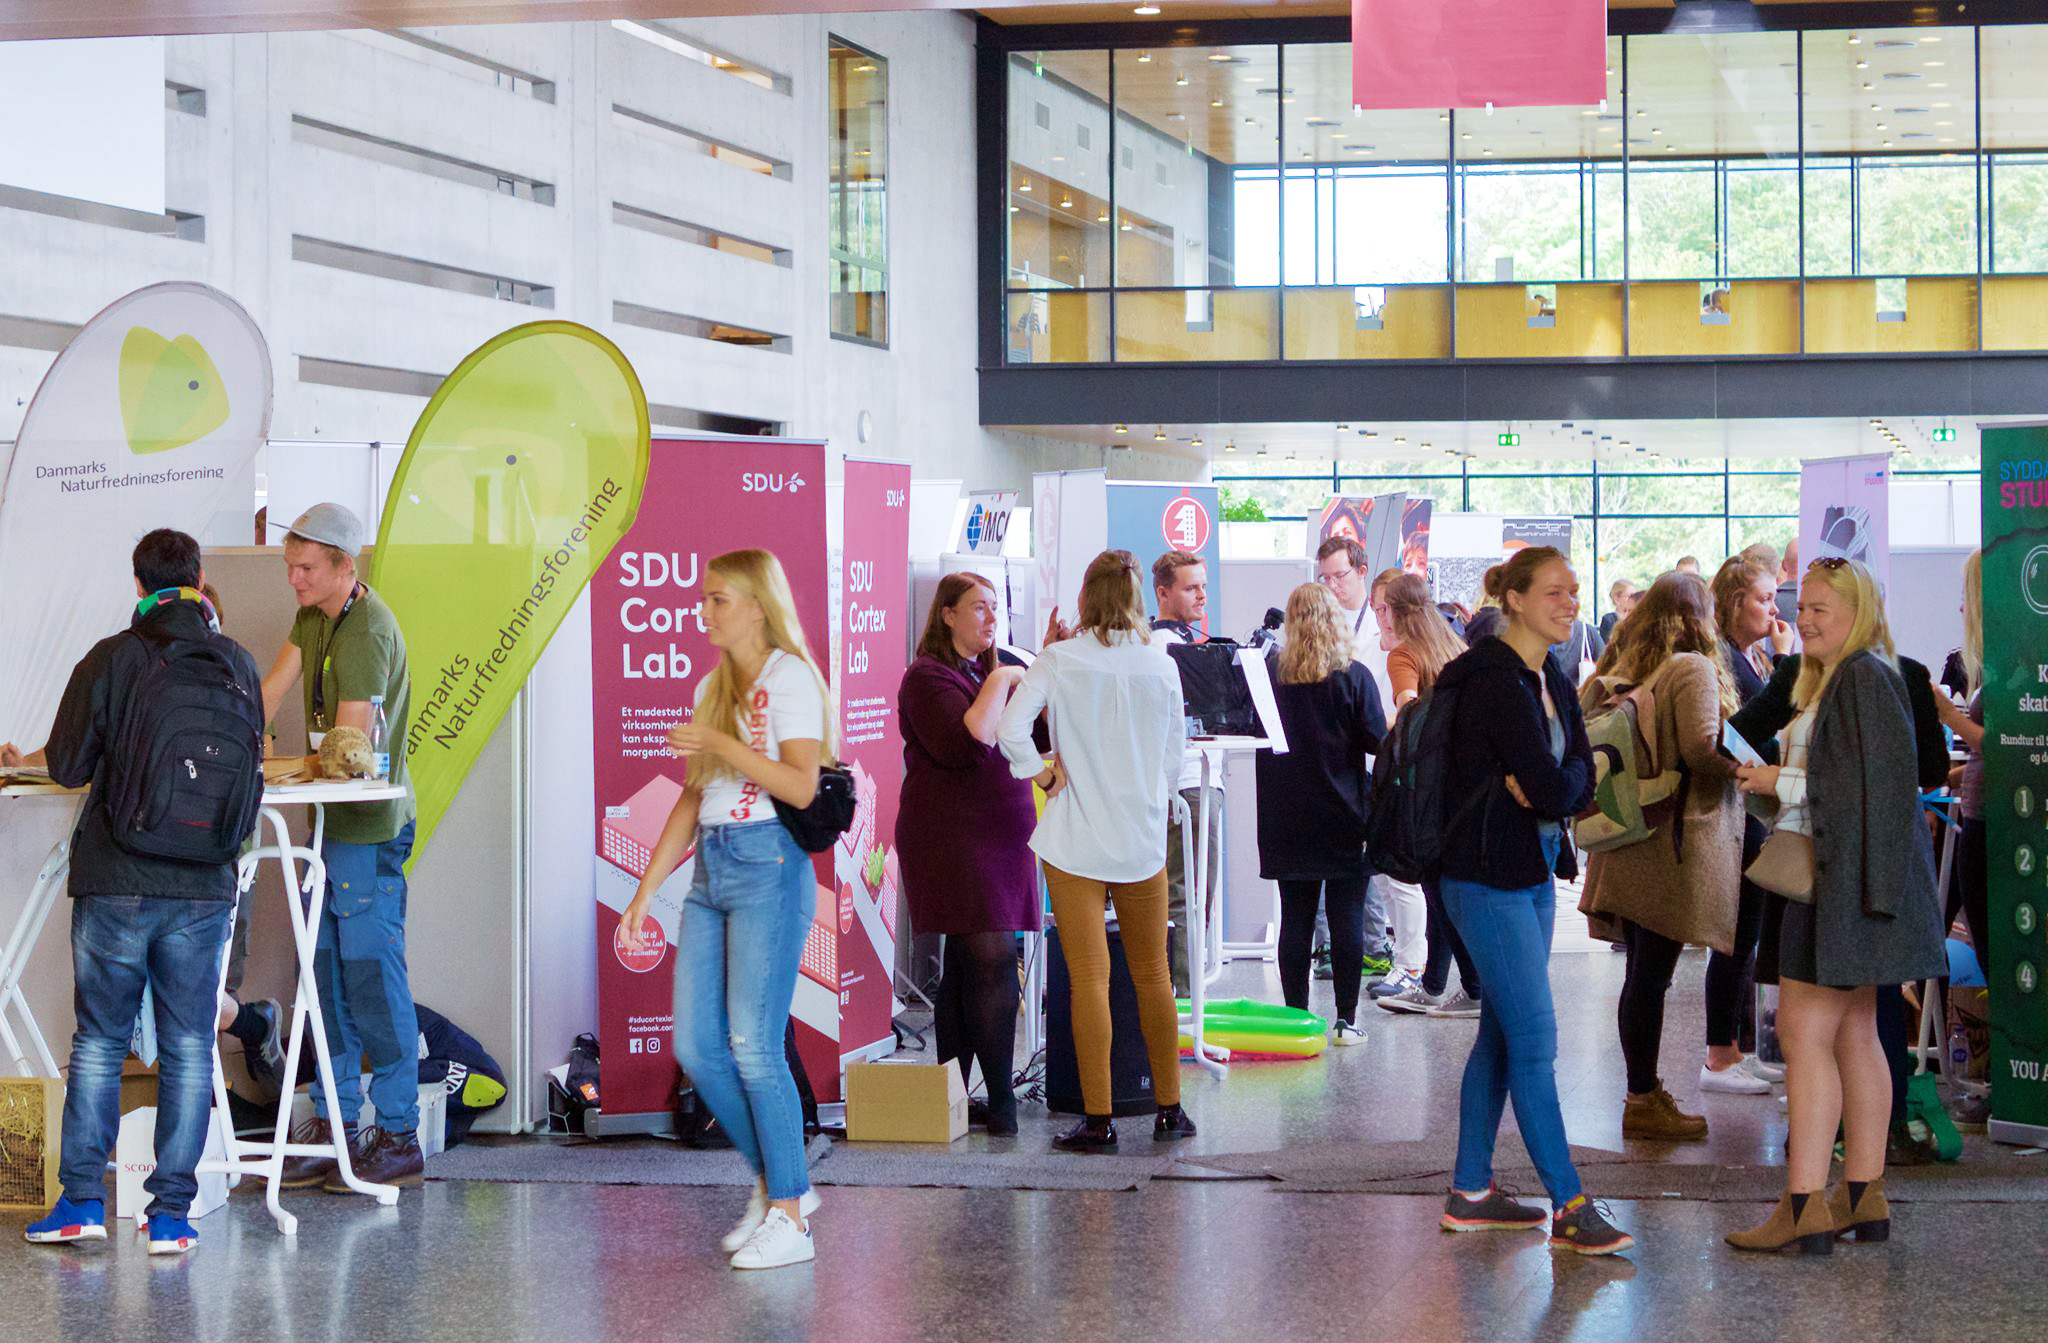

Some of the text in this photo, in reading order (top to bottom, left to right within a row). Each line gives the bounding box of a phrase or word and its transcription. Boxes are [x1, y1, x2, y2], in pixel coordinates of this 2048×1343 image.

[36, 461, 106, 479] Danmarks
[61, 466, 224, 493] Naturfredningsforening
[742, 472, 784, 493] SDU
[886, 489, 899, 507] SDU
[618, 551, 698, 588] SDU
[850, 560, 873, 592] SDU
[433, 477, 623, 750] Naturfredningsforening
[620, 597, 708, 633] Cort
[849, 601, 886, 633] Cortex
[622, 643, 692, 679] Lab
[848, 641, 868, 674] Lab
[405, 653, 470, 763] anmarks
[621, 706, 695, 717] Et mødested hv
[622, 720, 688, 731] virksomhed
[622, 733, 640, 743] kan
[2000, 733, 2034, 746] Rundtur
[2035, 735, 2045, 746] til
[622, 747, 679, 760] morgendag
[2030, 752, 2040, 766] og
[2021, 790, 2028, 812] 1
[2019, 848, 2031, 871] 2
[2020, 906, 2031, 930] 3
[2020, 964, 2033, 988] 4
[628, 1015, 674, 1024] #sducortexla
[2009, 1060, 2039, 1080] YOU
